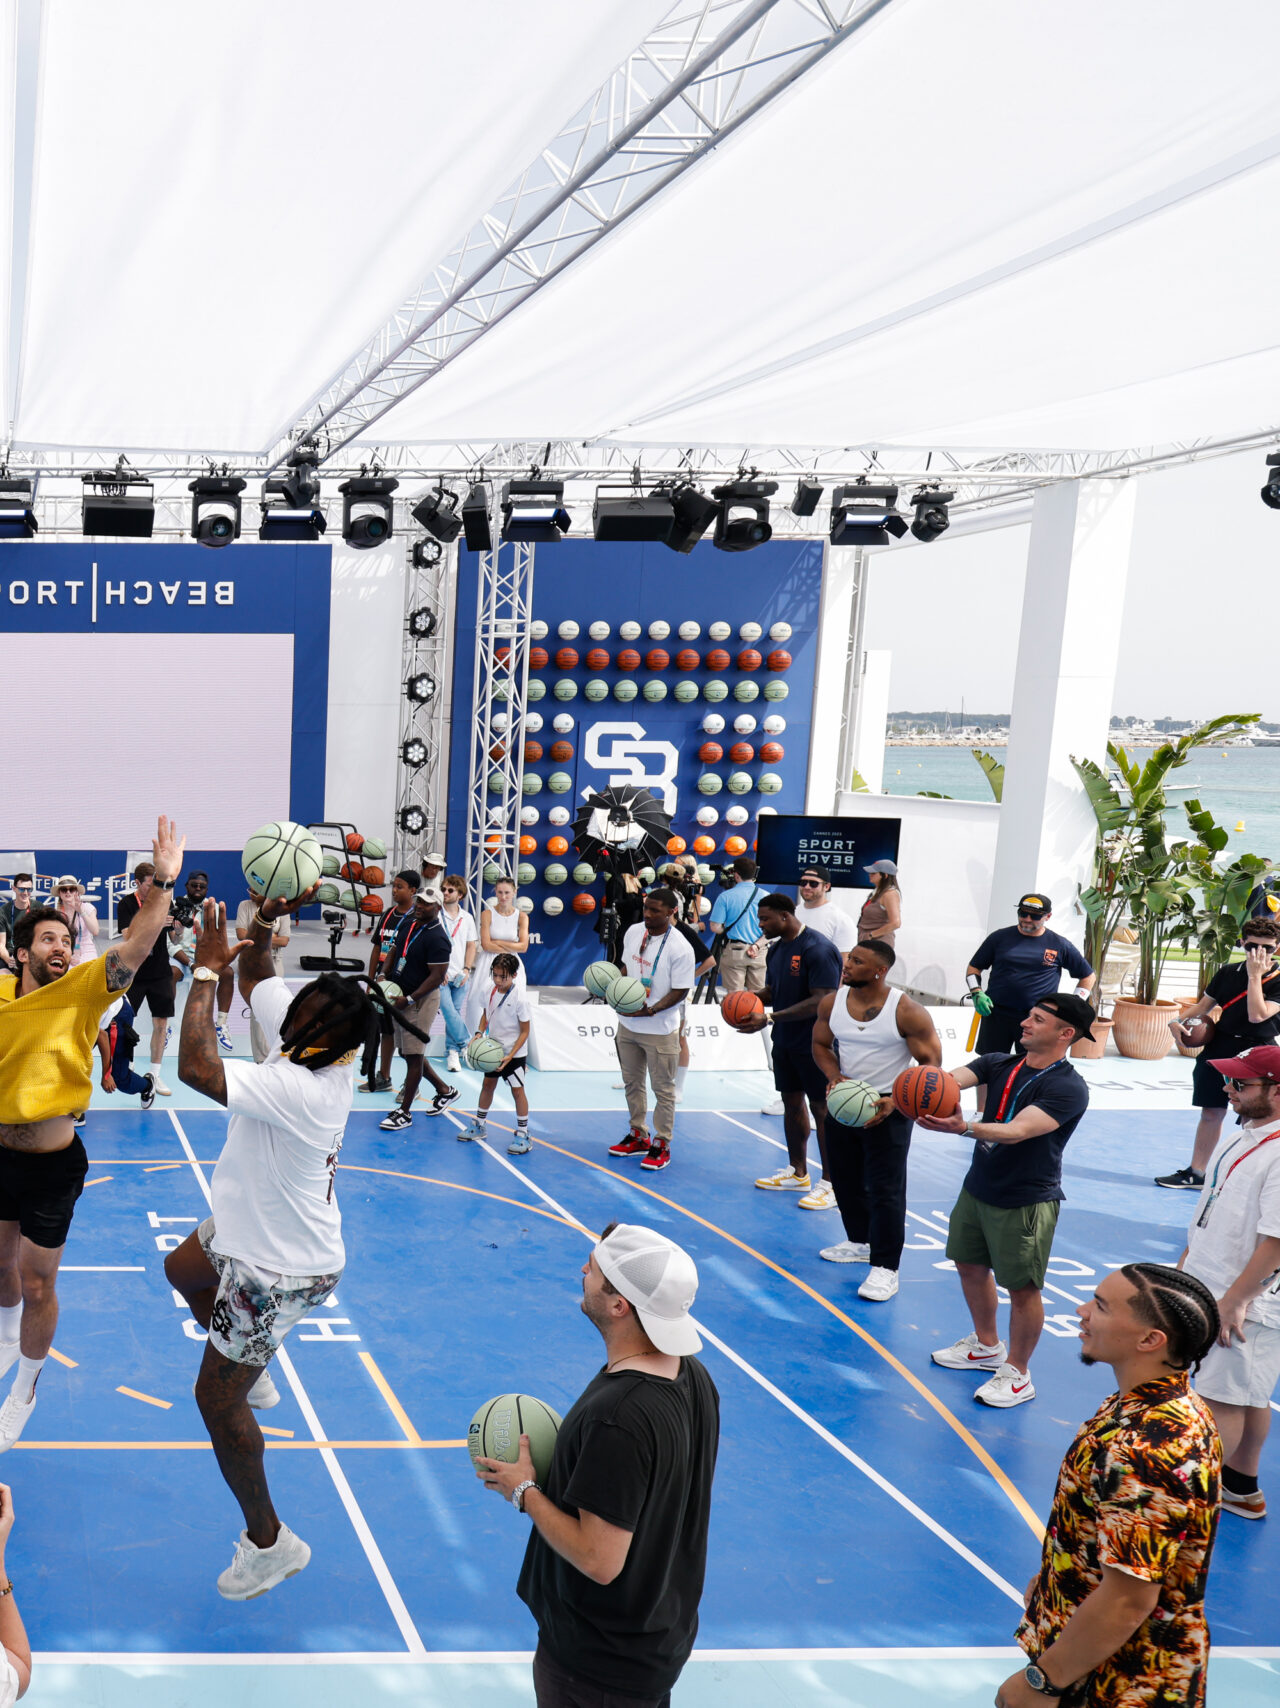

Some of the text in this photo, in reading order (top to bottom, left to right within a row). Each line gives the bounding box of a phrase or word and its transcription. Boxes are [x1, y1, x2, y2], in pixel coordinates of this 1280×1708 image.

[105, 580, 234, 605] BEACH
[799, 839, 855, 850] SPORT
[797, 854, 854, 865] BEACH
[577, 1025, 615, 1038] SPO
[920, 1071, 939, 1109] Wilson
